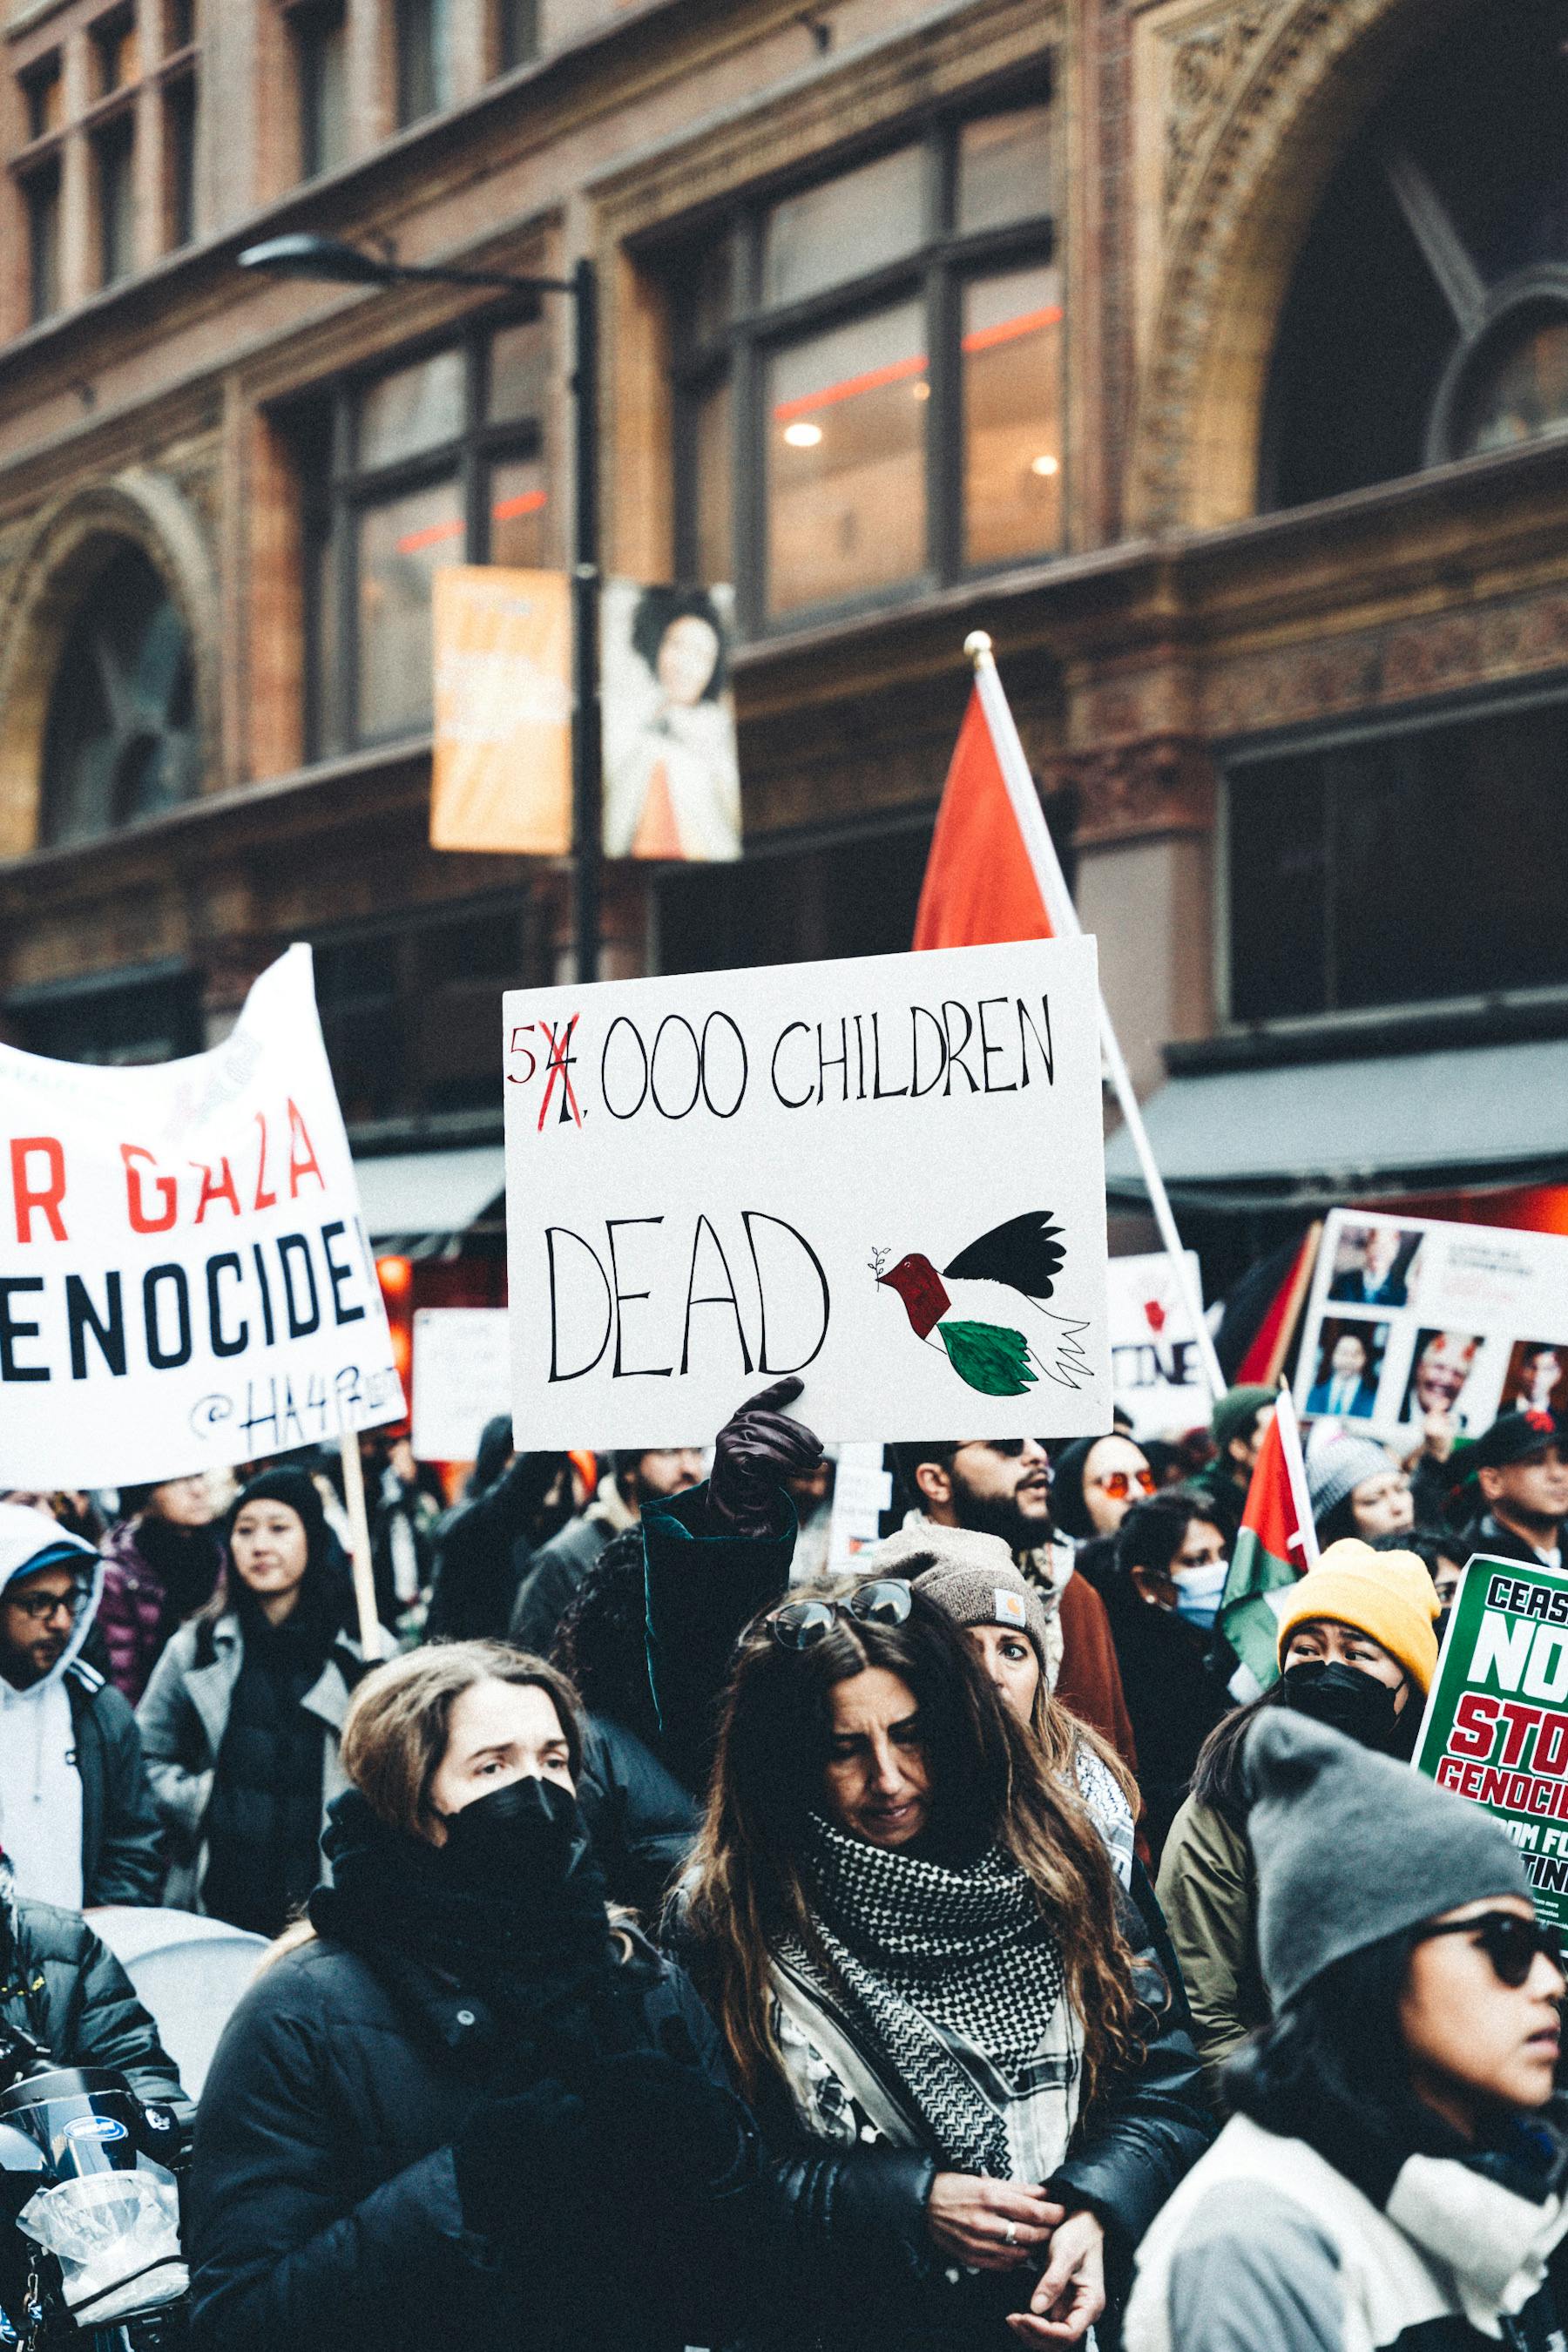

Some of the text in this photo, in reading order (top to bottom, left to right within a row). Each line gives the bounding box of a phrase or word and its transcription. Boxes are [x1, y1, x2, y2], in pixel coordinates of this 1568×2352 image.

[771, 994, 1055, 1108] CHILDREN
[544, 1210, 830, 1382] DEAD
[1484, 1574, 1568, 1625] CEAS
[1467, 1610, 1568, 1704] NO
[1519, 1851, 1568, 1896] TIN
